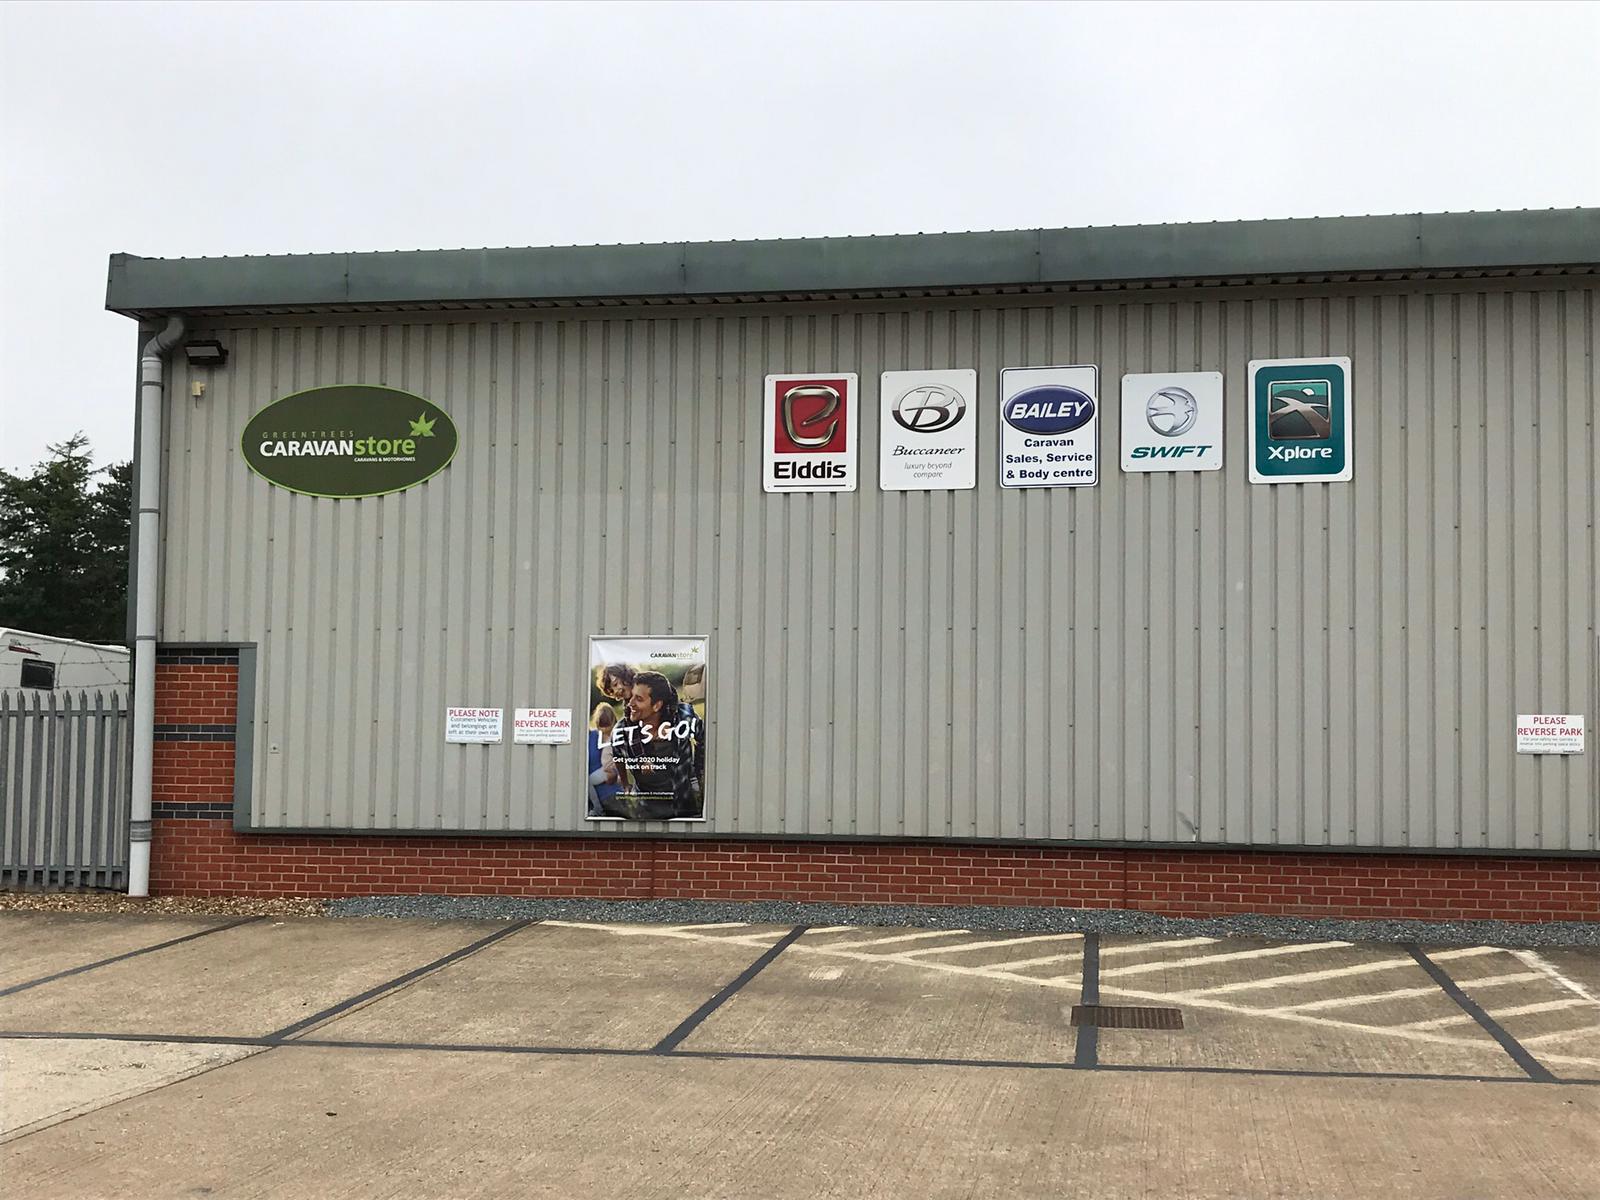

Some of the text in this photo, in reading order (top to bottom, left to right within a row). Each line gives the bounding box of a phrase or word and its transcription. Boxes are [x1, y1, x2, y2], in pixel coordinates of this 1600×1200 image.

[1010, 401, 1088, 419] BAILEY
[262, 430, 354, 439] GREENTREES
[260, 436, 416, 457] CARAVANstore
[1024, 438, 1074, 447] Caravan
[892, 445, 965, 456] Buccaneer
[1131, 445, 1212, 459] SWIFT
[1268, 446, 1332, 462] Xplore
[1006, 453, 1092, 464] Sales, Service
[774, 461, 846, 478] Elddis
[904, 461, 952, 470] luxury beyond
[913, 471, 943, 479] compare
[1006, 469, 1093, 480] & Body centre
[1534, 716, 1566, 724] PLEASE
[597, 718, 697, 750] LET'S GO!
[1518, 728, 1556, 736] REVERSE
